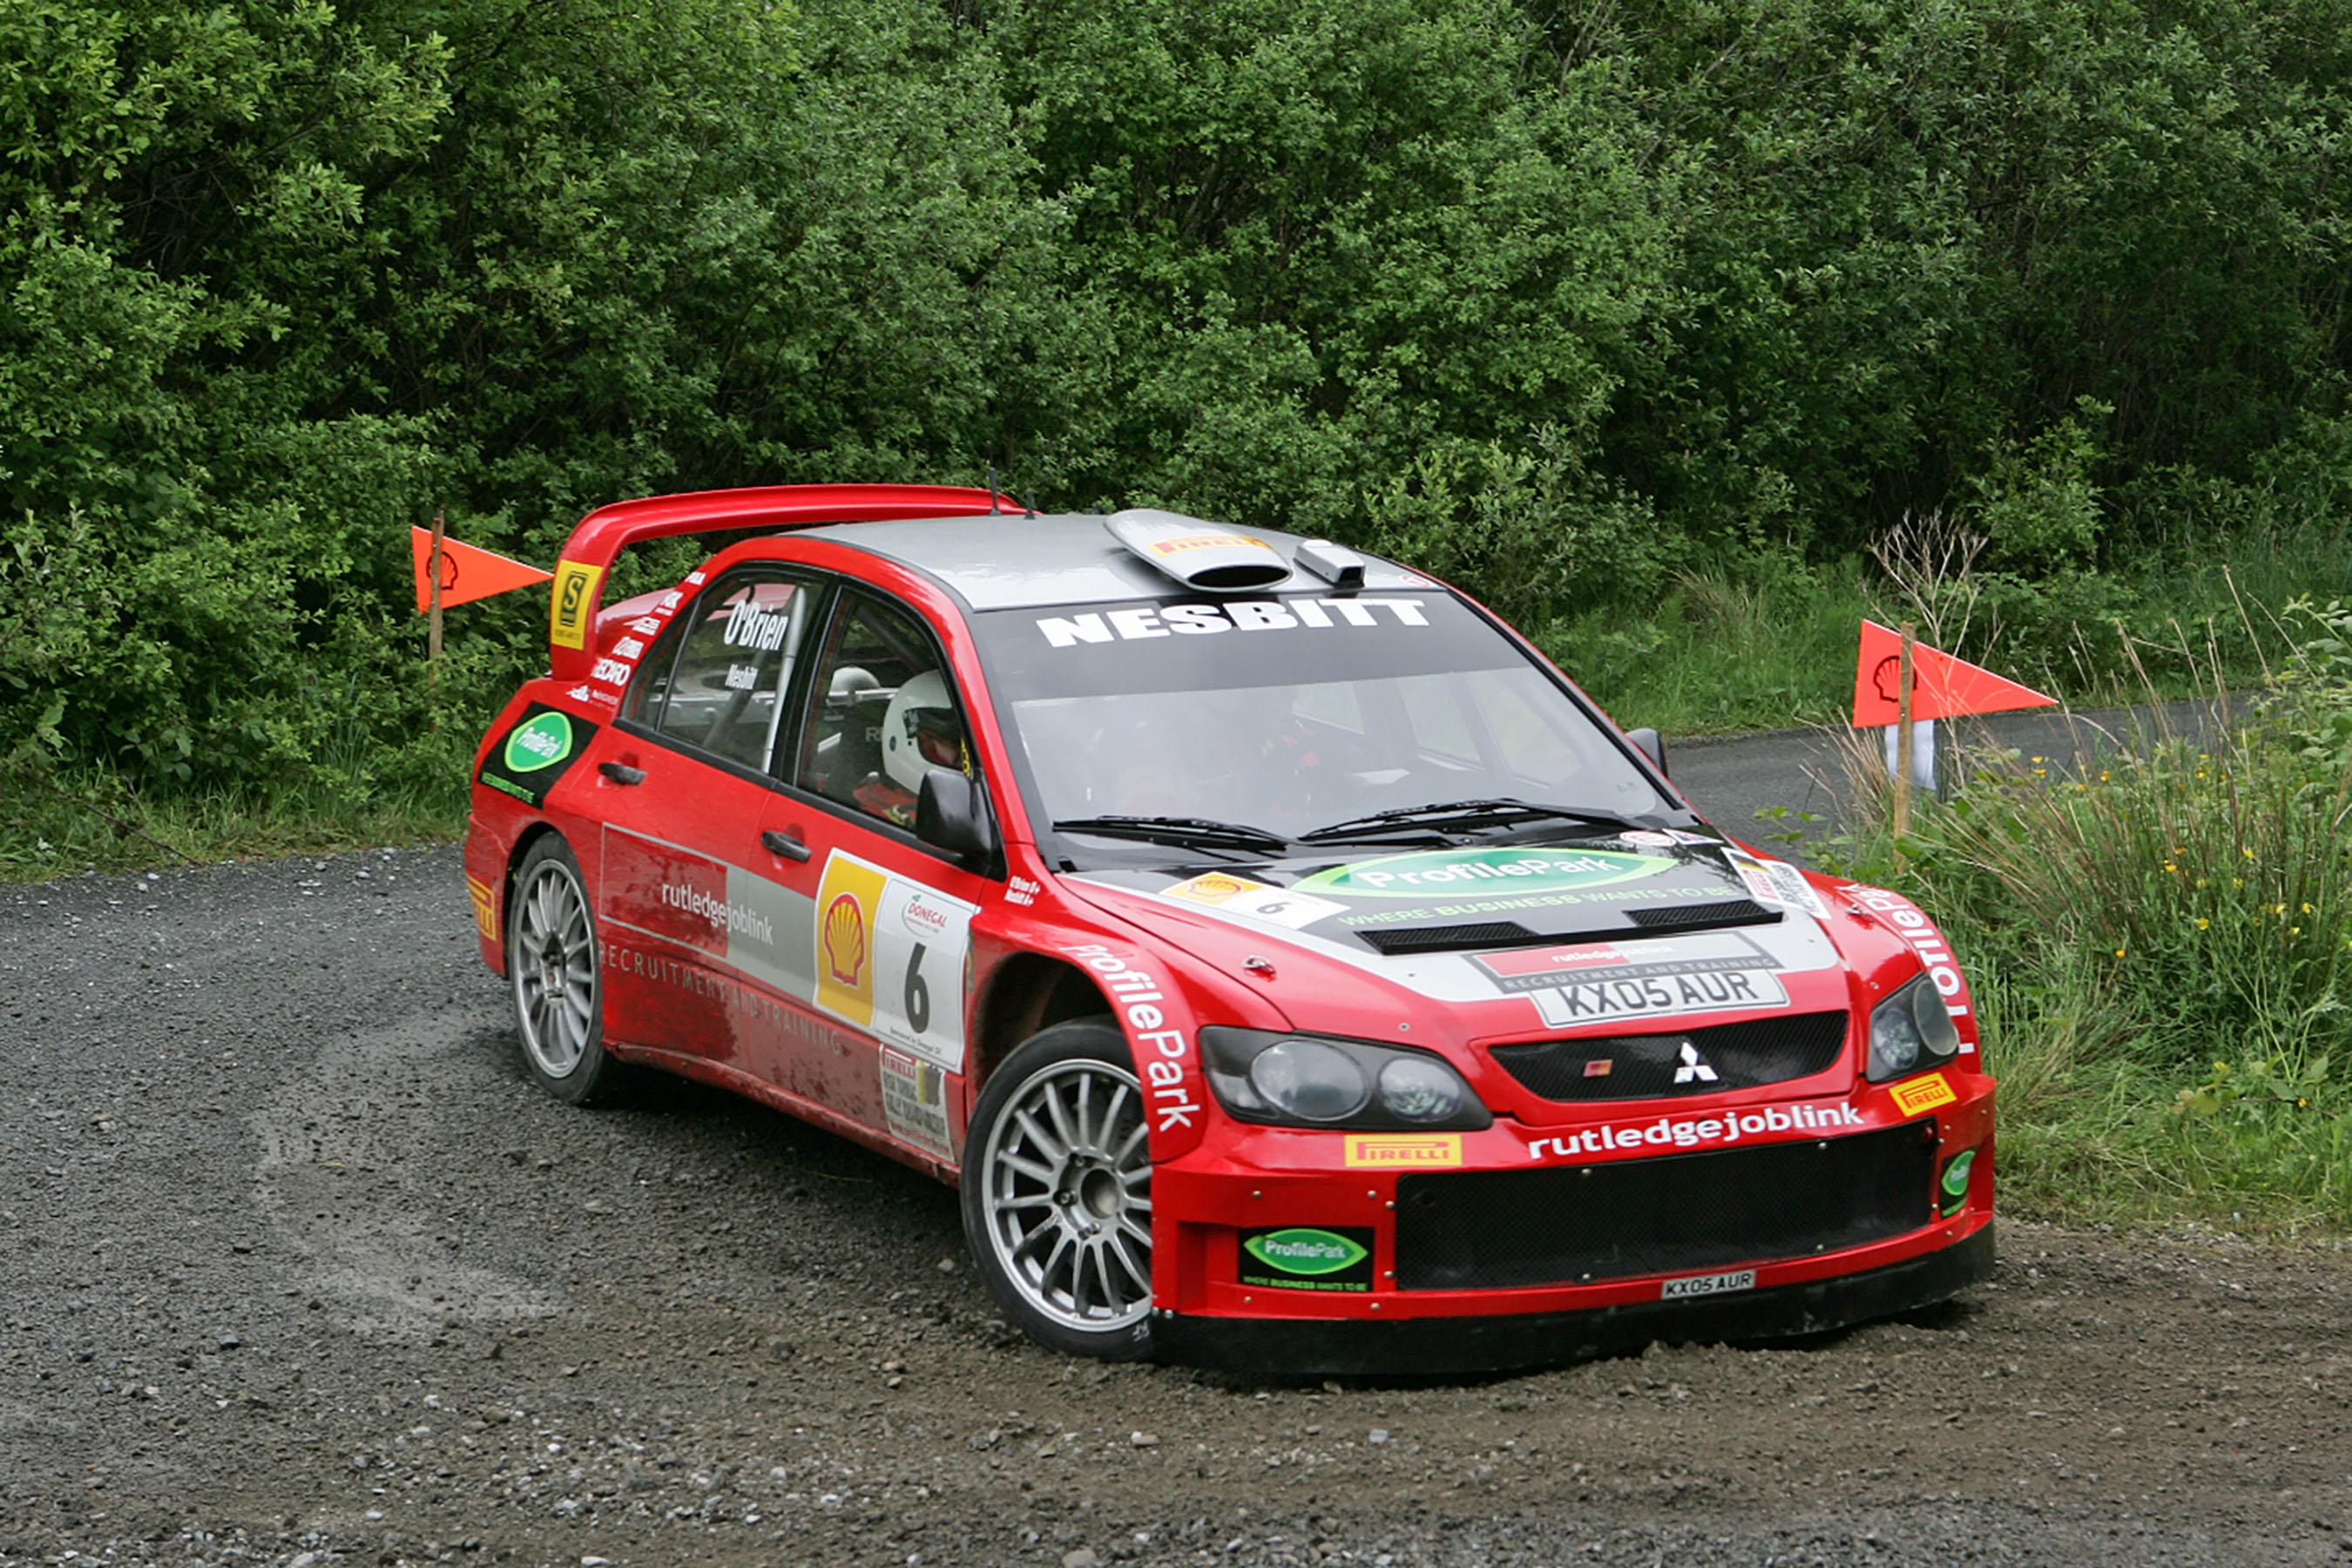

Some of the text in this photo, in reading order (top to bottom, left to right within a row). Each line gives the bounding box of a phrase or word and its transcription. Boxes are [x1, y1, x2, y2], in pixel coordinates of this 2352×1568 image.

[724, 599, 788, 651] O'Brien
[1036, 598, 1430, 648] NESBITT
[1356, 856, 1622, 889] ProfilePark
[662, 883, 774, 946] rutledgejoblink
[907, 902, 948, 928] DONEGAL
[1339, 885, 1740, 926] WHERE BUSINESS WANTS TO BE
[904, 942, 929, 1034] 6
[1503, 957, 1777, 990] RECRUITMENT AND TRAINING
[598, 940, 727, 1001] RECRUITMENT
[763, 999, 843, 1055] TRAINING
[1557, 972, 1760, 1017] KX05 AUR
[1058, 944, 1200, 1132] ProfilePark
[1898, 1079, 1949, 1110] PIRELLI
[1356, 1141, 1450, 1160] PIRELLI
[1528, 1101, 1864, 1159] rutledgejoblink
[1264, 1239, 1346, 1259] ProfilePark
[1270, 1278, 1315, 1289] BUSINESS
[1665, 1273, 1752, 1295] KX05 AUR
